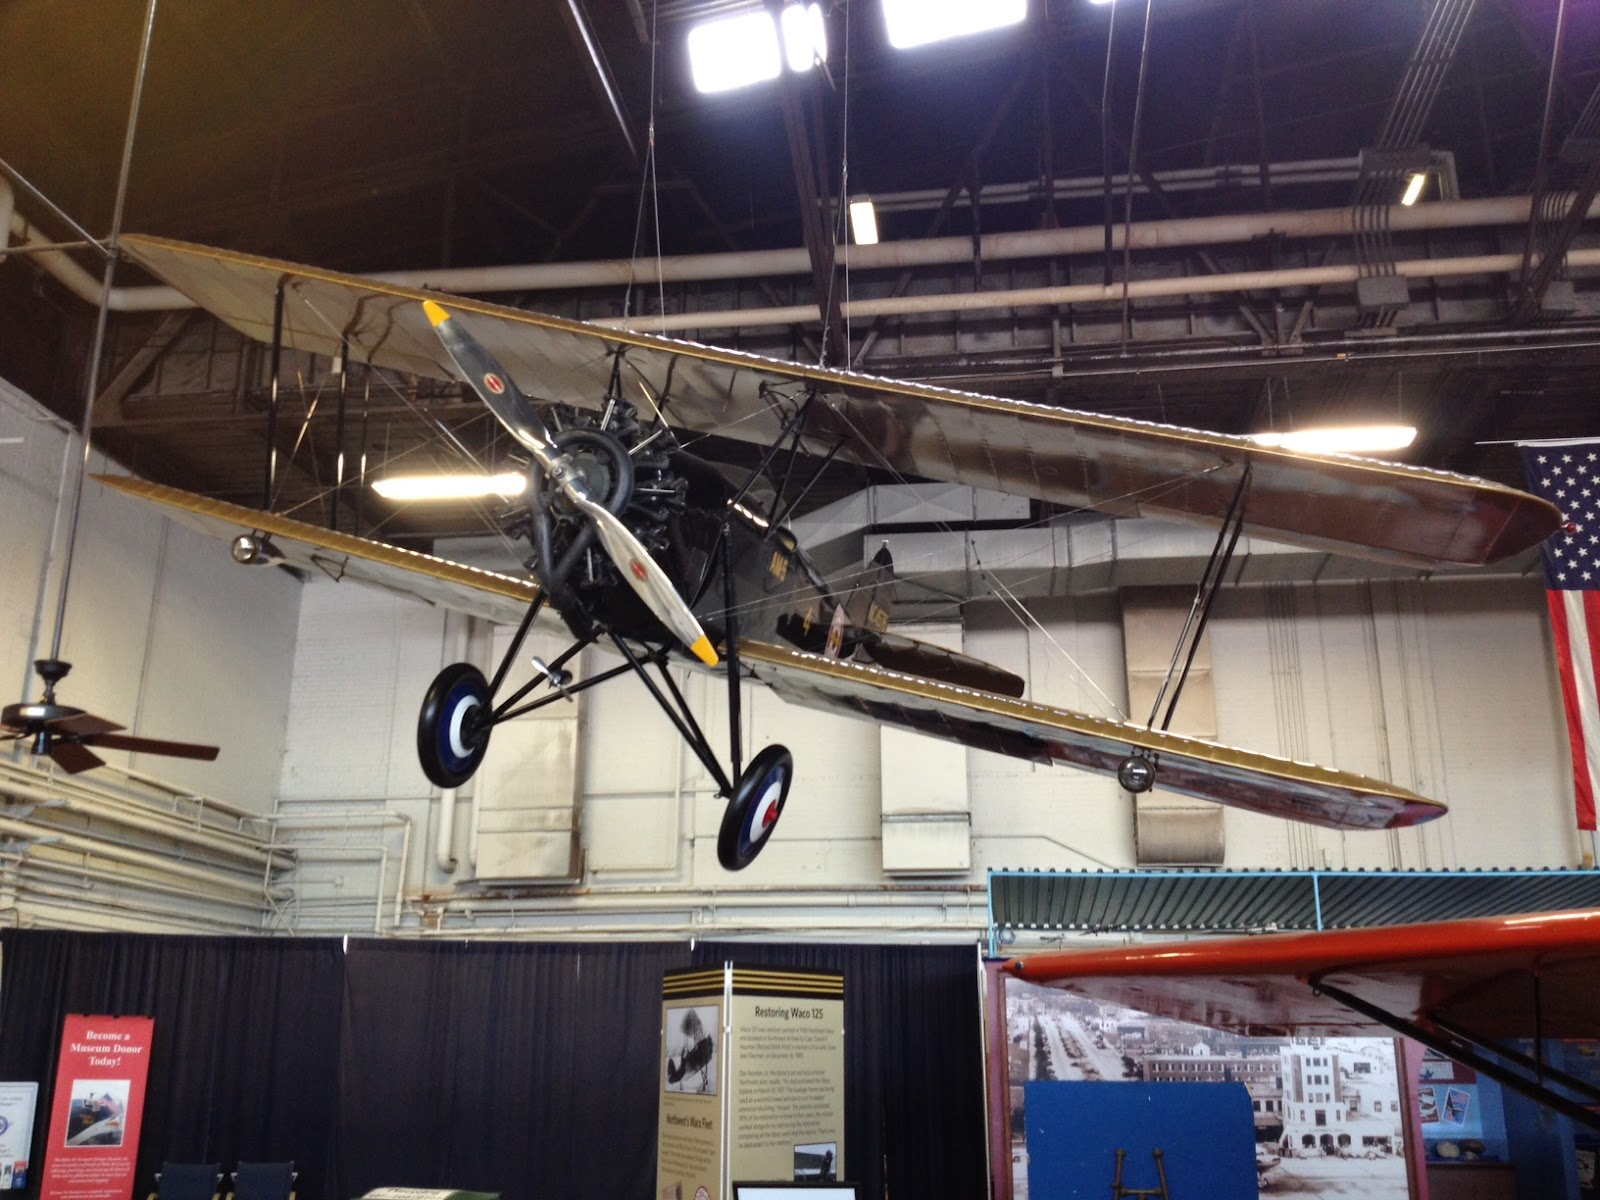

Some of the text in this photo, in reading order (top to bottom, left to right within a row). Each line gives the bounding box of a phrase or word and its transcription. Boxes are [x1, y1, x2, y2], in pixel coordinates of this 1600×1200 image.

[755, 1006, 823, 1020] Restoring Waco 125
[86, 1030, 122, 1041] Become
[70, 1043, 142, 1053] Museum Donor
[89, 1056, 121, 1068] Today!
